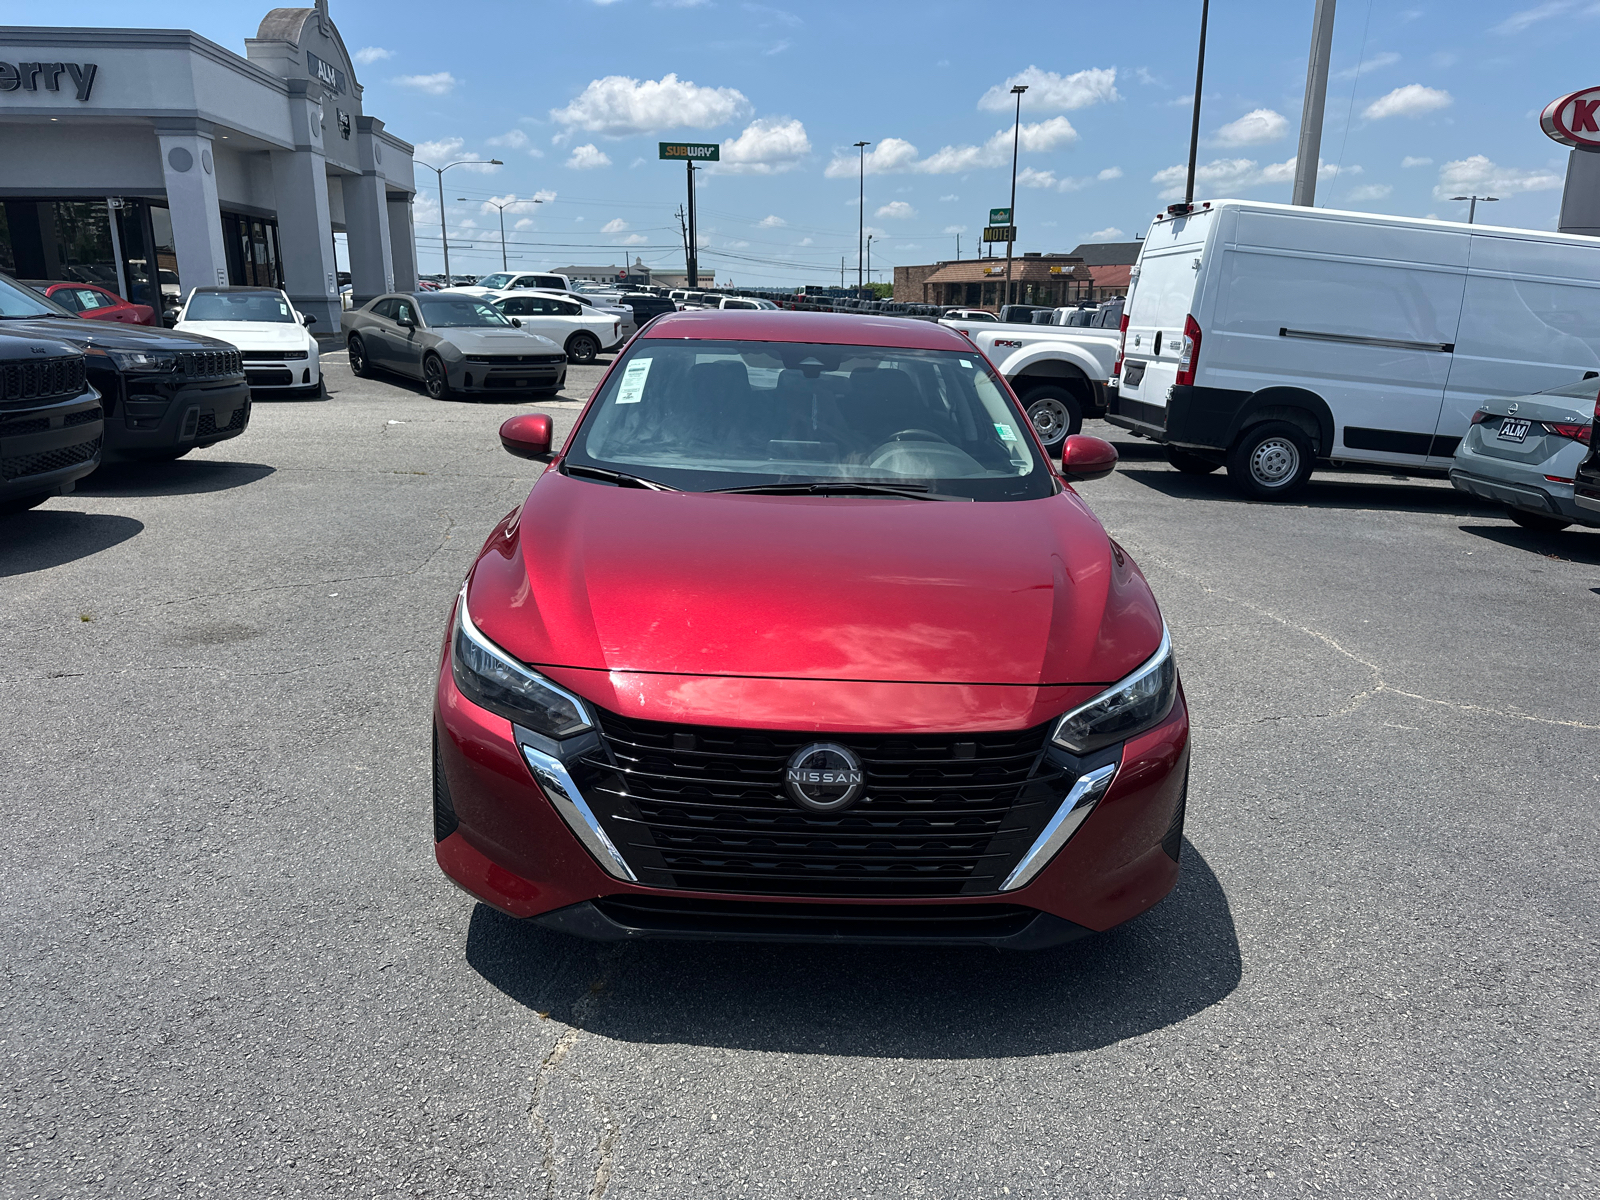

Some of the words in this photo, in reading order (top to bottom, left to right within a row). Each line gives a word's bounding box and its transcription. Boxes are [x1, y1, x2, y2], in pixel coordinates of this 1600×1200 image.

[318, 59, 337, 87] ALM
[0, 61, 98, 101] erry
[665, 146, 715, 157] SUBWAY
[984, 228, 1012, 241] MOTE
[1501, 423, 1527, 437] ALM
[788, 770, 861, 783] NISSAN
